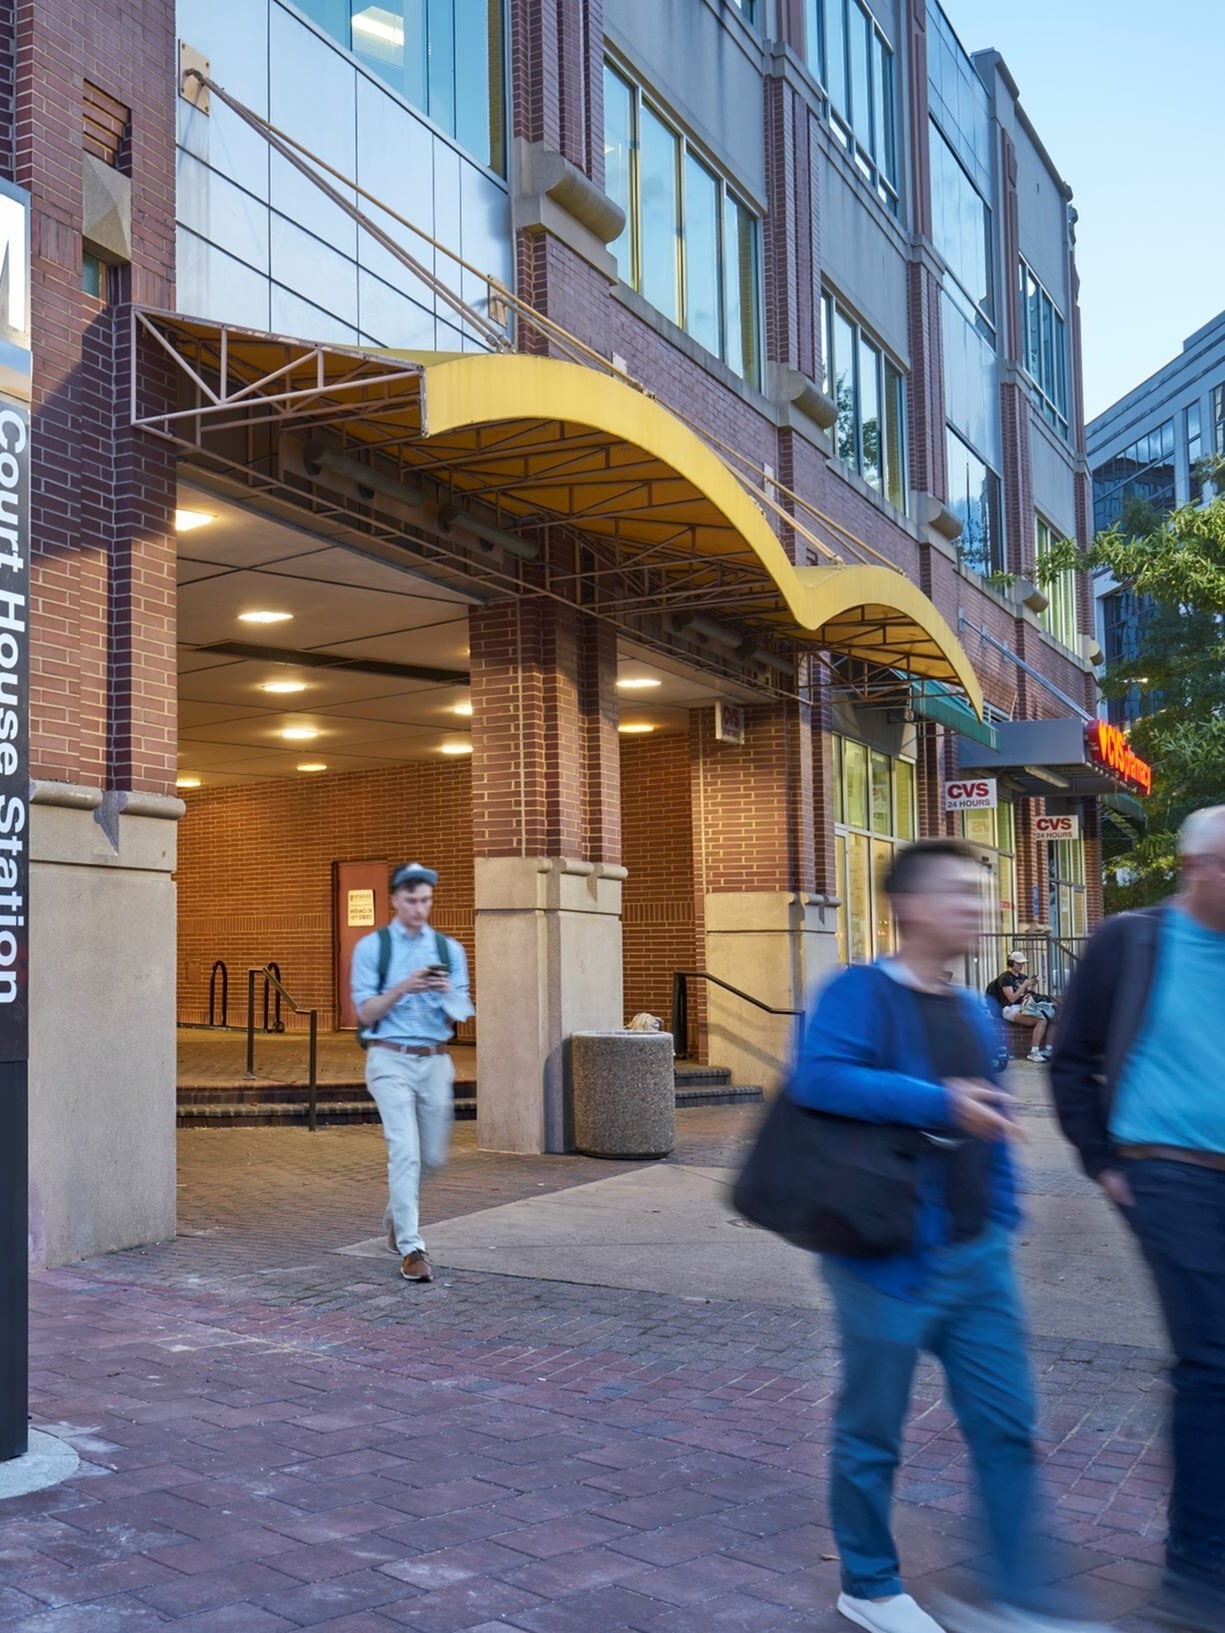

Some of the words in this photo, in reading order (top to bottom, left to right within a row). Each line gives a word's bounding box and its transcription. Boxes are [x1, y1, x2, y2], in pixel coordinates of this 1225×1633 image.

[1108, 724, 1126, 772] CVS
[947, 782, 989, 799] CVS
[947, 800, 958, 808] 24
[958, 799, 990, 807] HOURS
[1036, 817, 1072, 832] CVS
